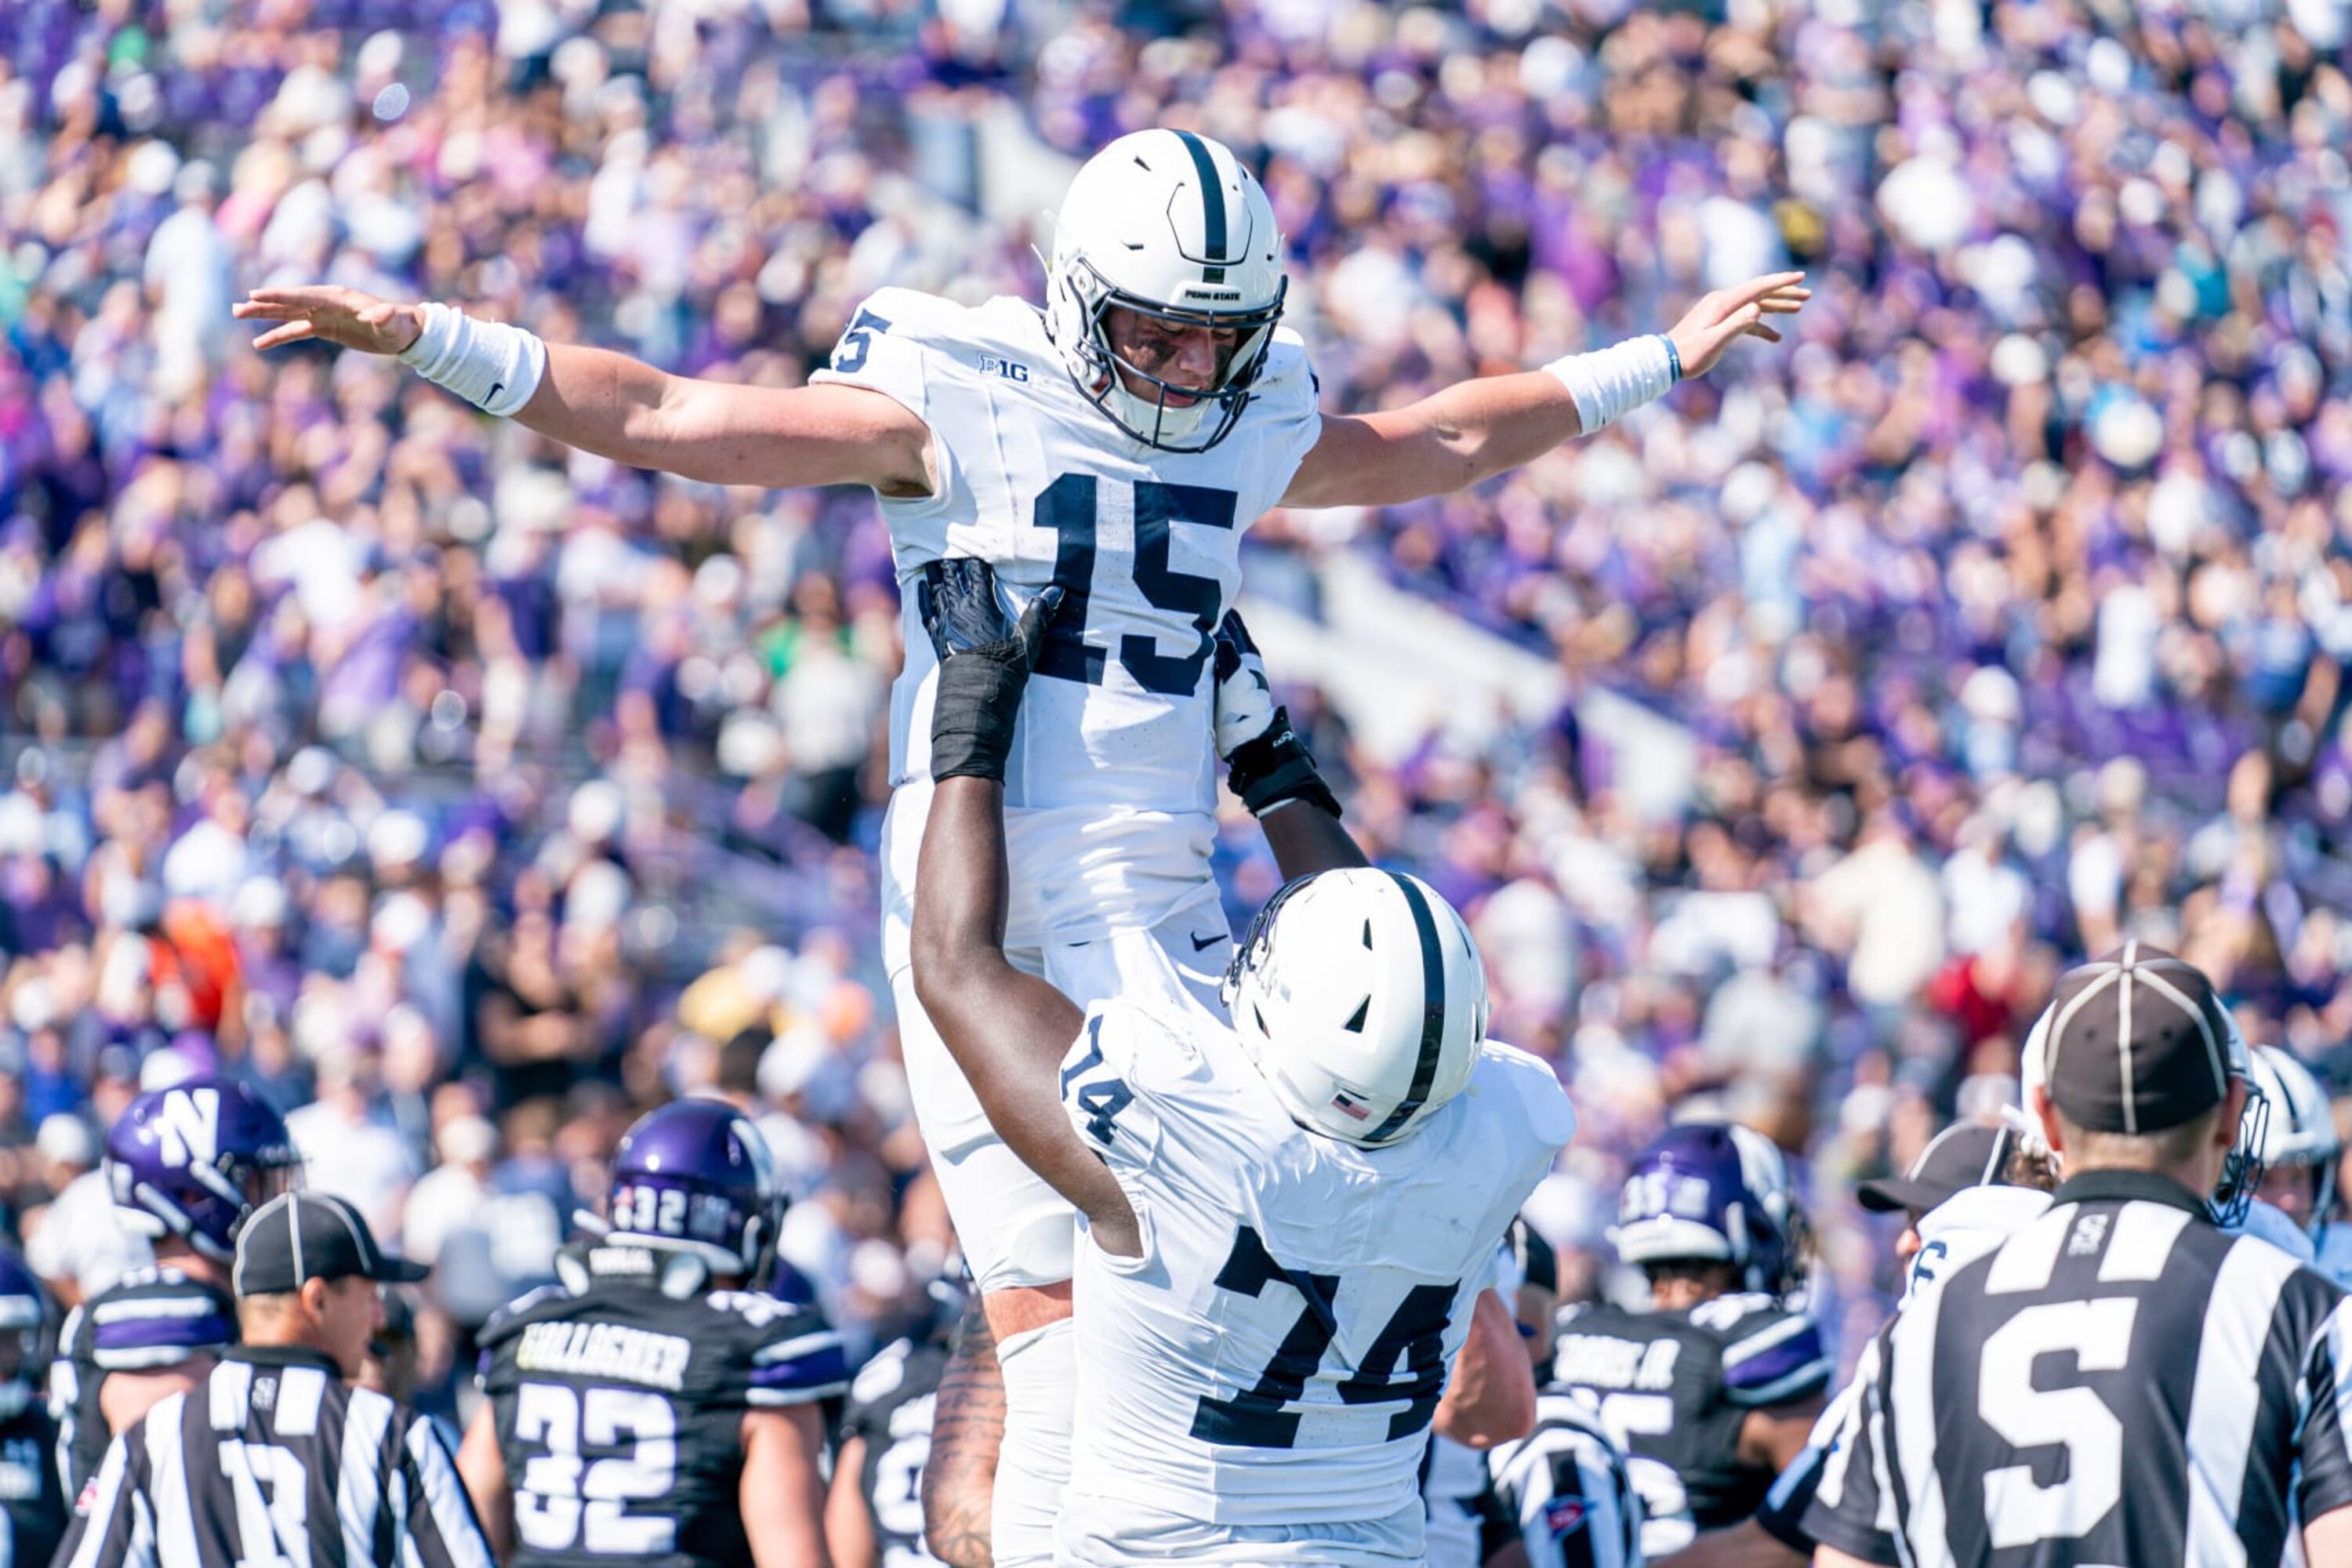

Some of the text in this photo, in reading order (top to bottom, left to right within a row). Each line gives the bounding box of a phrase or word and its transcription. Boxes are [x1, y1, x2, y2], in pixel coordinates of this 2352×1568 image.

[836, 307, 892, 372] 5
[1185, 289, 1211, 299] PENN
[1031, 472, 1238, 696] 15
[160, 1088, 220, 1167] N
[633, 1185, 686, 1234] 32
[1190, 1226, 1461, 1449] 74
[514, 1382, 676, 1554] 32
[1979, 1297, 2138, 1549] S
[218, 1438, 312, 1568] R
